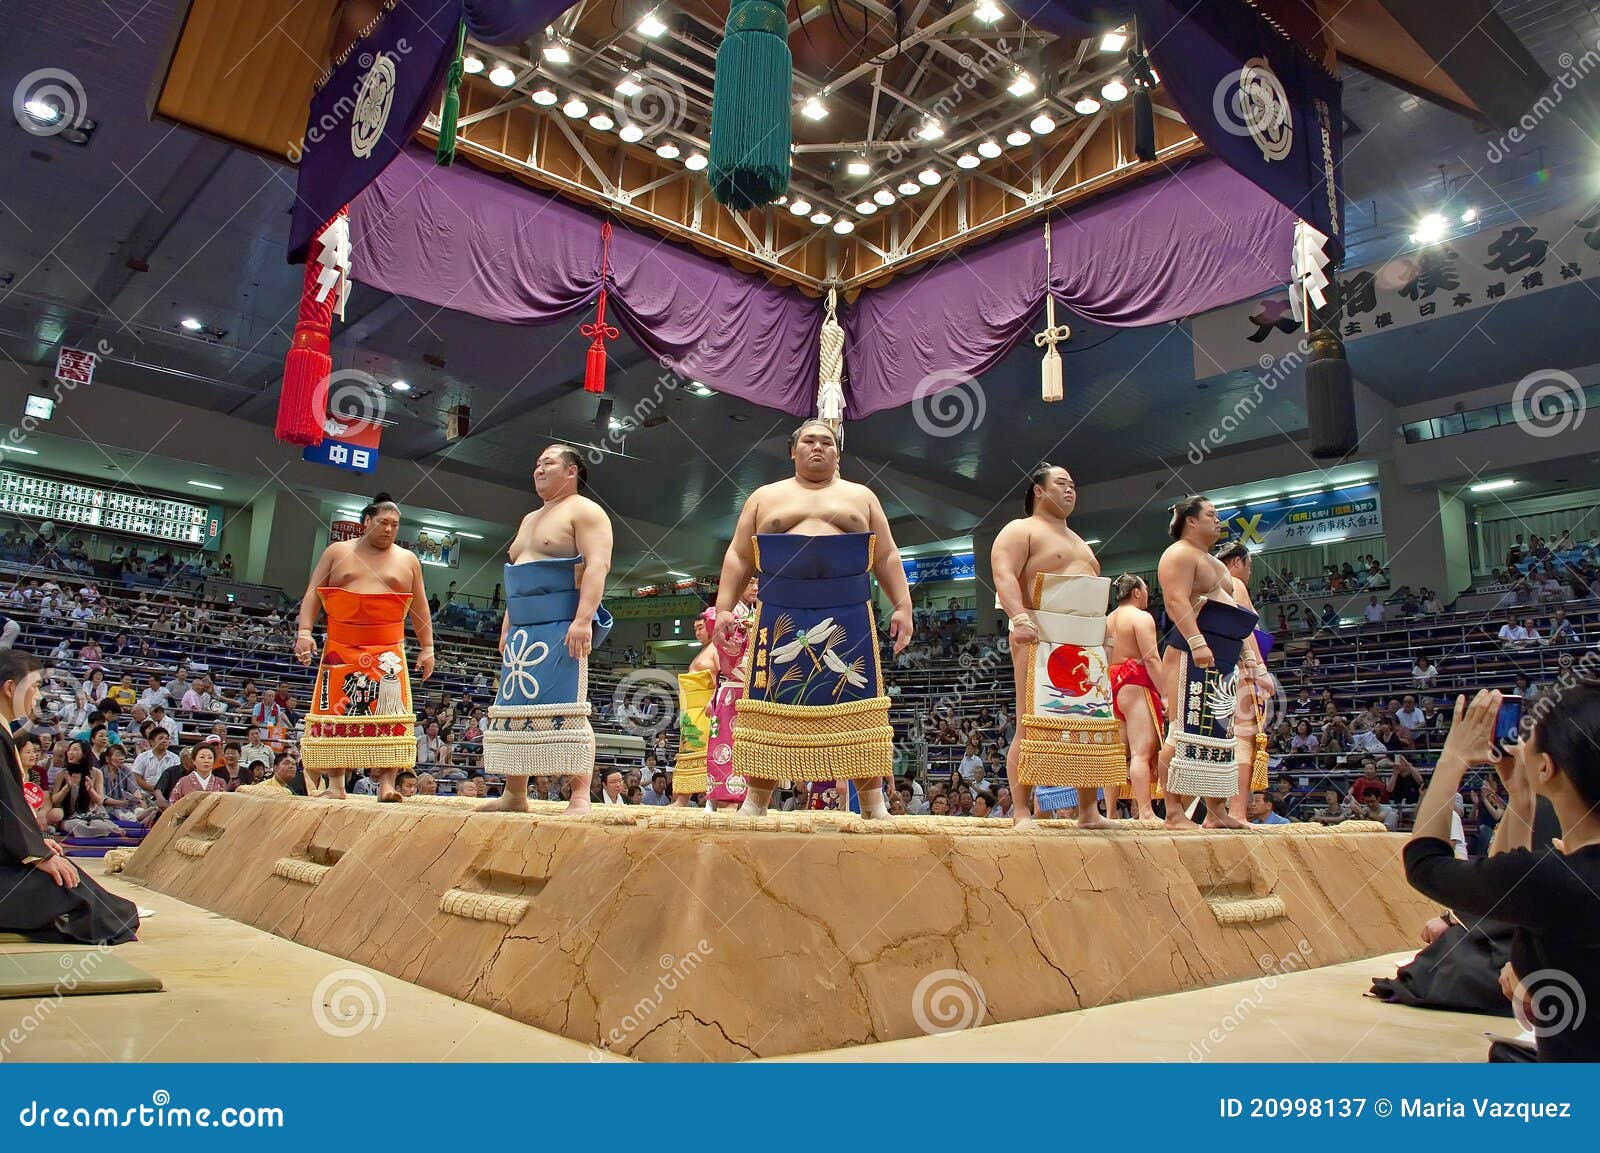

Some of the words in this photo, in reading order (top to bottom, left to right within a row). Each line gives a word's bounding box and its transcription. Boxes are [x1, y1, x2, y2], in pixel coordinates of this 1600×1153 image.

[329, 445, 370, 468] 中日
[1278, 603, 1300, 621] 12
[647, 623, 661, 638] 13
